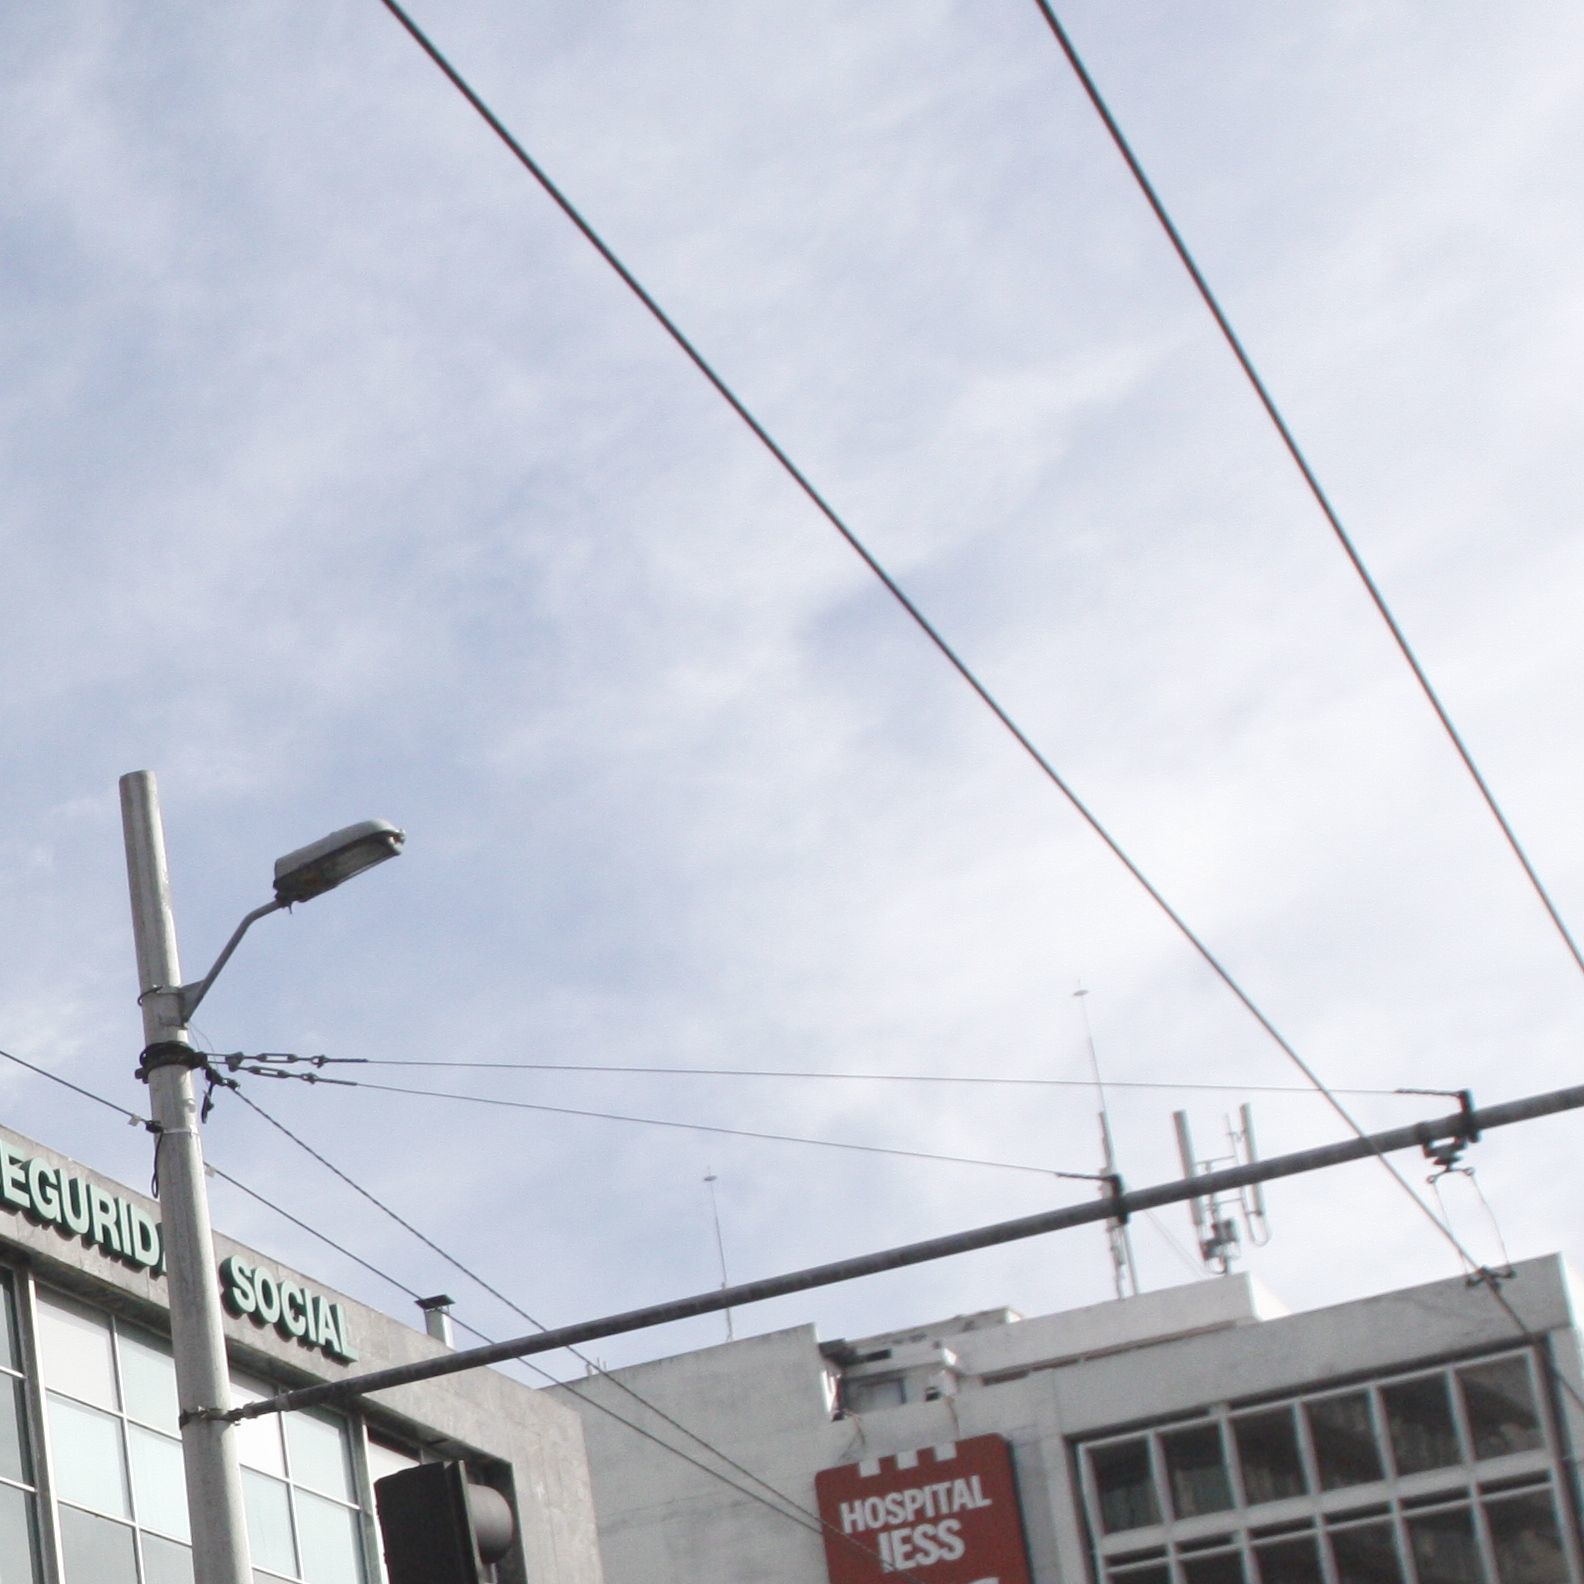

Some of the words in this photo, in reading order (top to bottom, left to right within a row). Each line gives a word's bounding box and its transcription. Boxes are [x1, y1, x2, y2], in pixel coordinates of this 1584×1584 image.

[223, 1255, 358, 1363] SOCIAL
[840, 1474, 992, 1535] HOSPITAL
[878, 1518, 965, 1574] IESS
